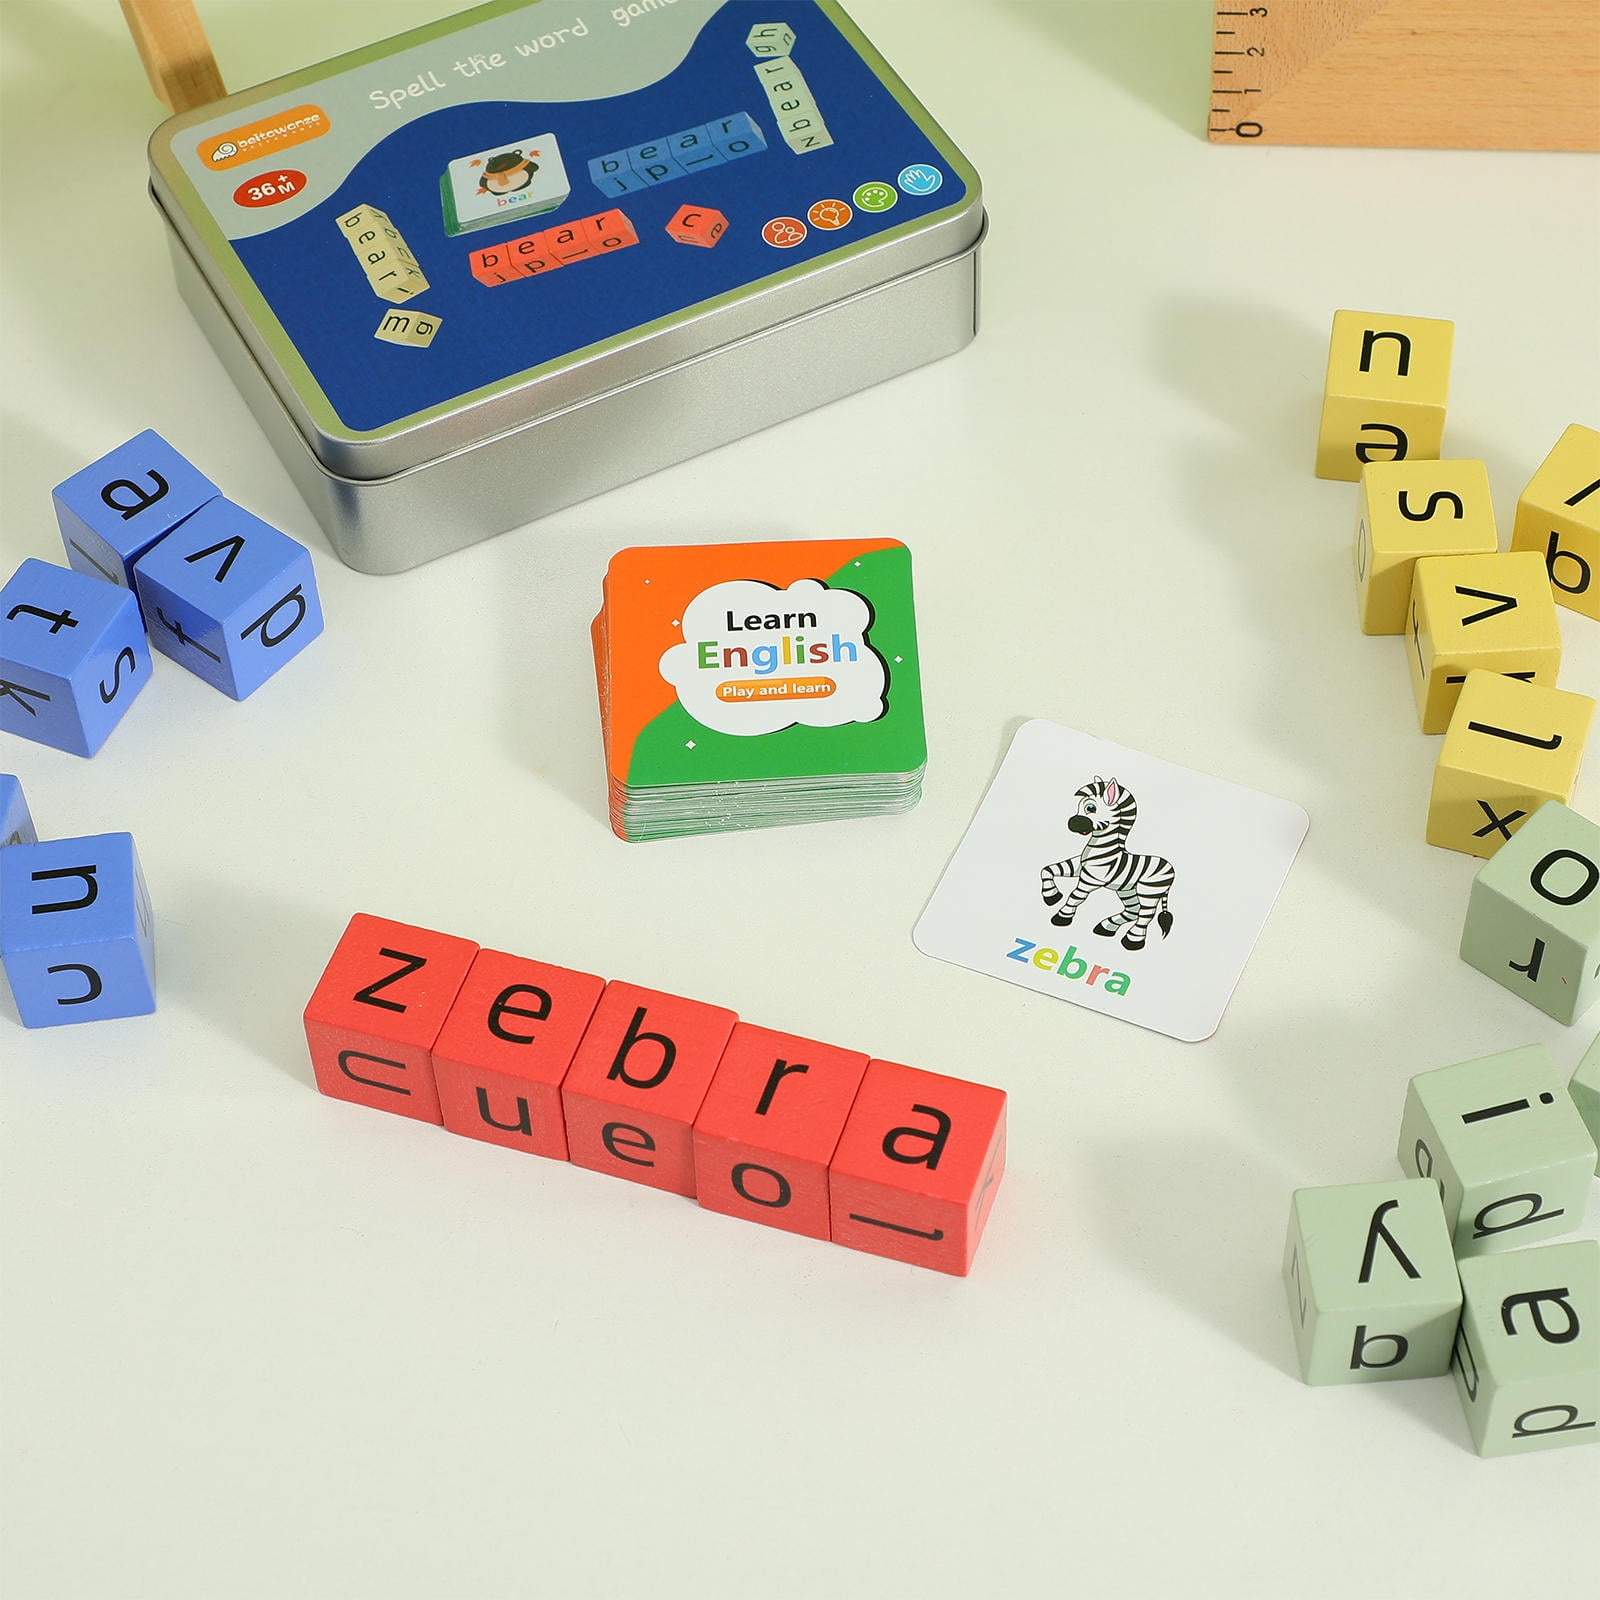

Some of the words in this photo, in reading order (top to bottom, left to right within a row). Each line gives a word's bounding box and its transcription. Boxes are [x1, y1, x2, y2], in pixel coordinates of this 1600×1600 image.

[1249, 7, 1268, 17] 3
[369, 71, 446, 109] Spell
[453, 51, 507, 77] the
[515, 17, 589, 57] word
[1246, 47, 1265, 56] 2
[497, 191, 533, 207] bear
[101, 469, 169, 520] a
[1398, 490, 1463, 522] s
[727, 611, 817, 631] Learn
[698, 634, 857, 674] English
[722, 685, 754, 699] Play
[759, 682, 787, 696] and
[792, 681, 830, 695] learn
[1007, 938, 1131, 996] zebra
[1501, 1287, 1580, 1344] a
